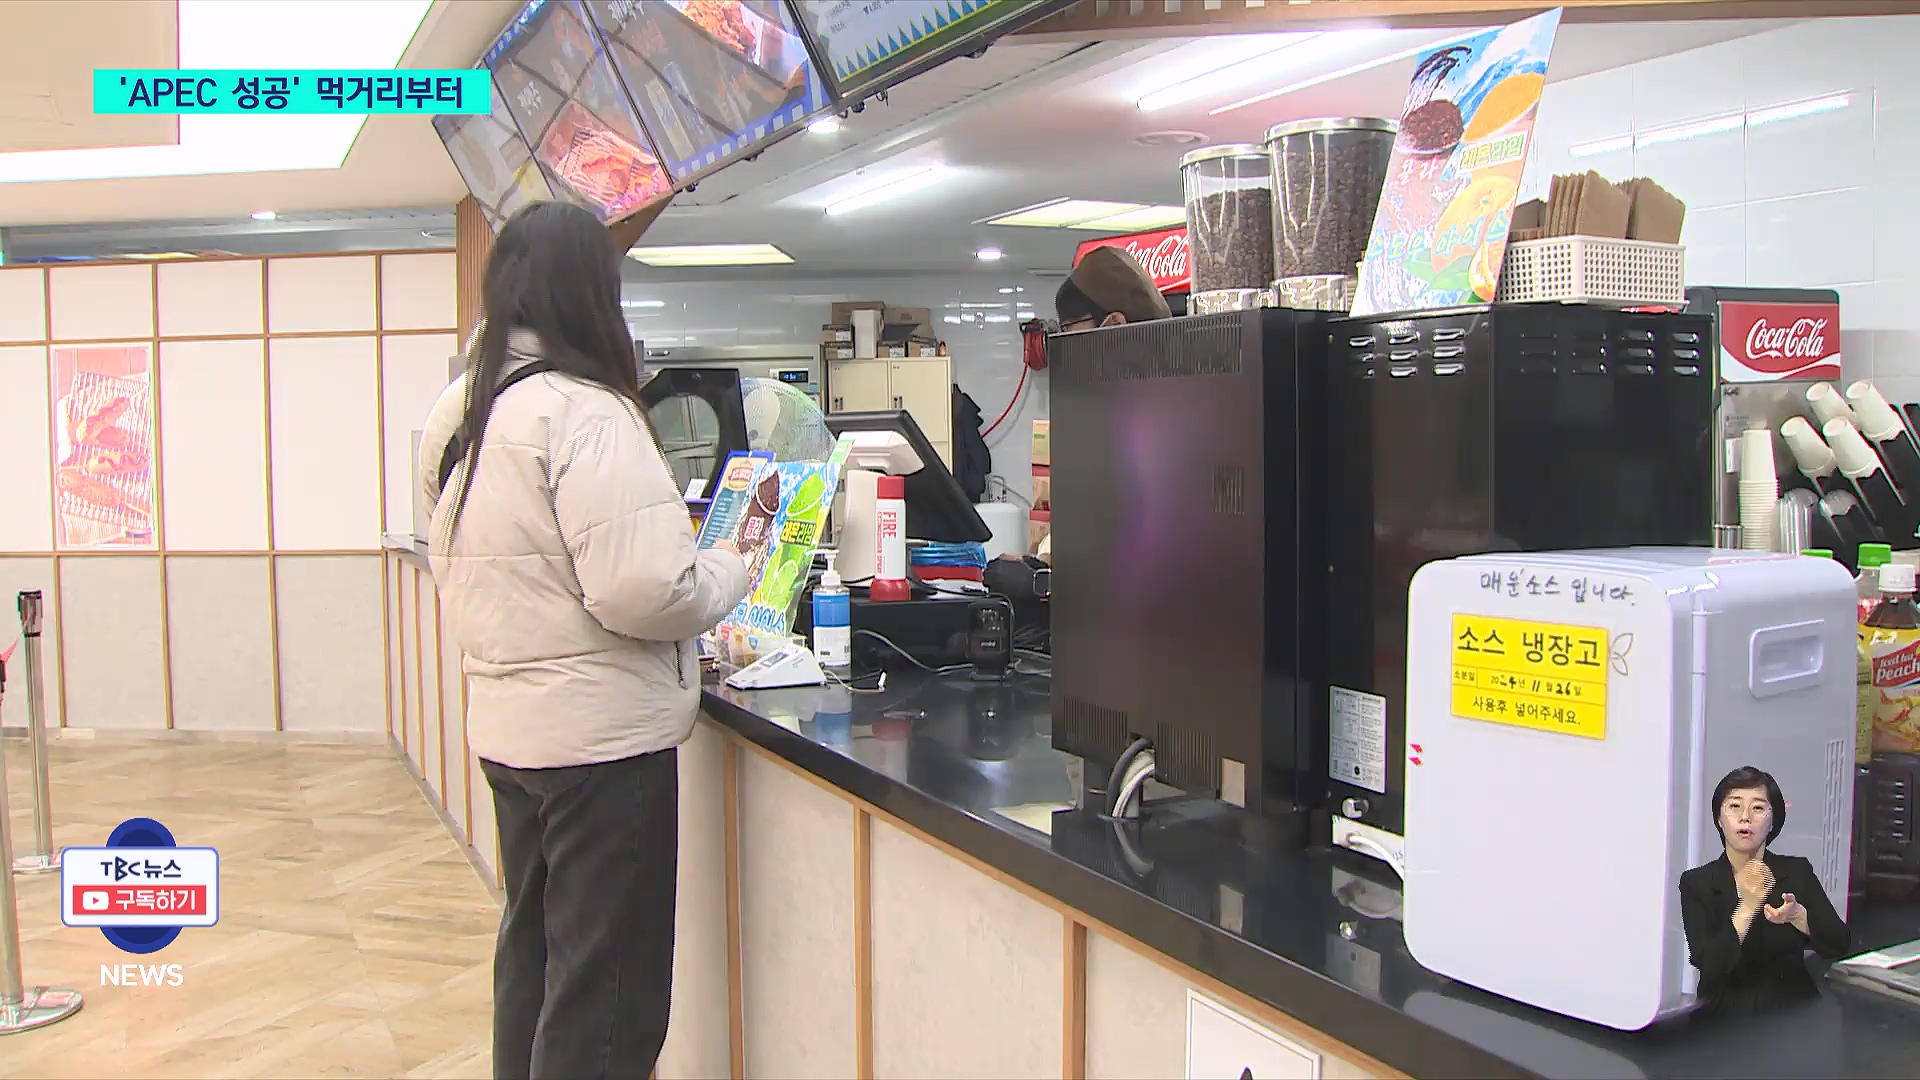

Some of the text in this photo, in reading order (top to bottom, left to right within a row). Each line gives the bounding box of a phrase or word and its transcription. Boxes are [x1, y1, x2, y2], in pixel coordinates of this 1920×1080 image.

[1434, 209, 1508, 258] 아이스
[1745, 317, 1828, 359] Coca-Cola
[781, 519, 816, 546] 레몬라임
[882, 511, 897, 539] FIRE
[1457, 626, 1601, 667] 소스 냉장고
[1876, 657, 1920, 685] Peach
[1473, 695, 1581, 725] 사용후 넣어주세요.
